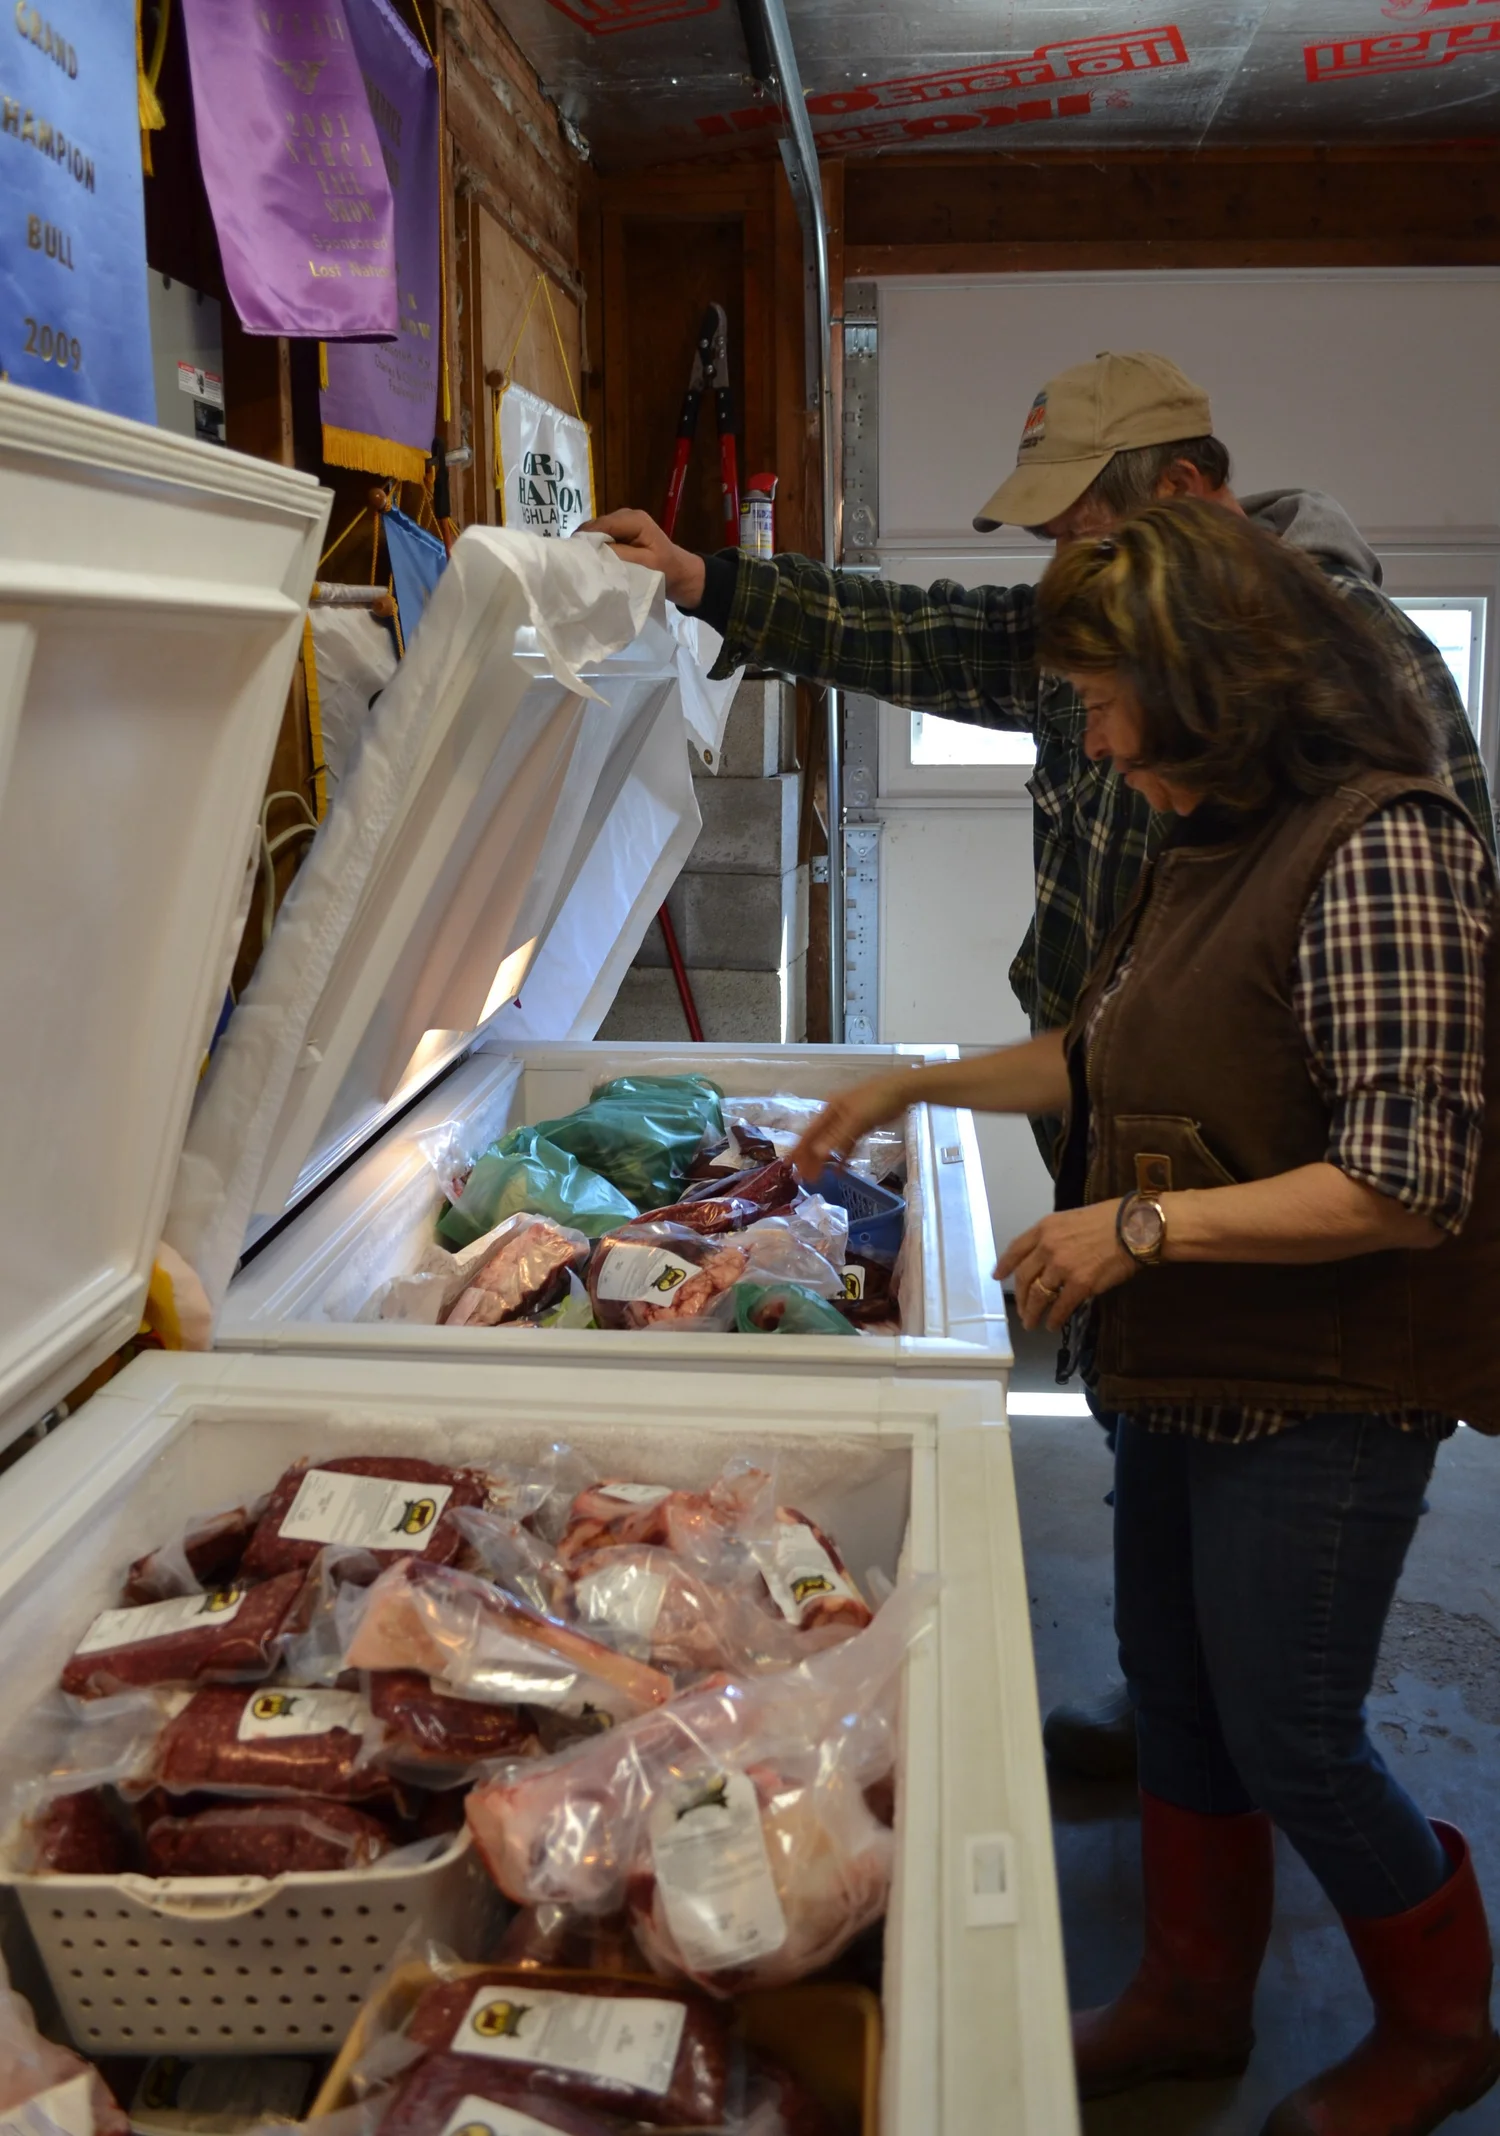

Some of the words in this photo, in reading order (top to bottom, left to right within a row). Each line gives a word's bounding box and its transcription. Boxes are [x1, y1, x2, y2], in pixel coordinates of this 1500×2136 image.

[16, 1, 78, 80] GRAND
[3, 95, 95, 194] HAMPION
[28, 213, 74, 271] BULL
[309, 260, 342, 278] Lost
[349, 261, 390, 278] Natio
[24, 316, 82, 373] 2009
